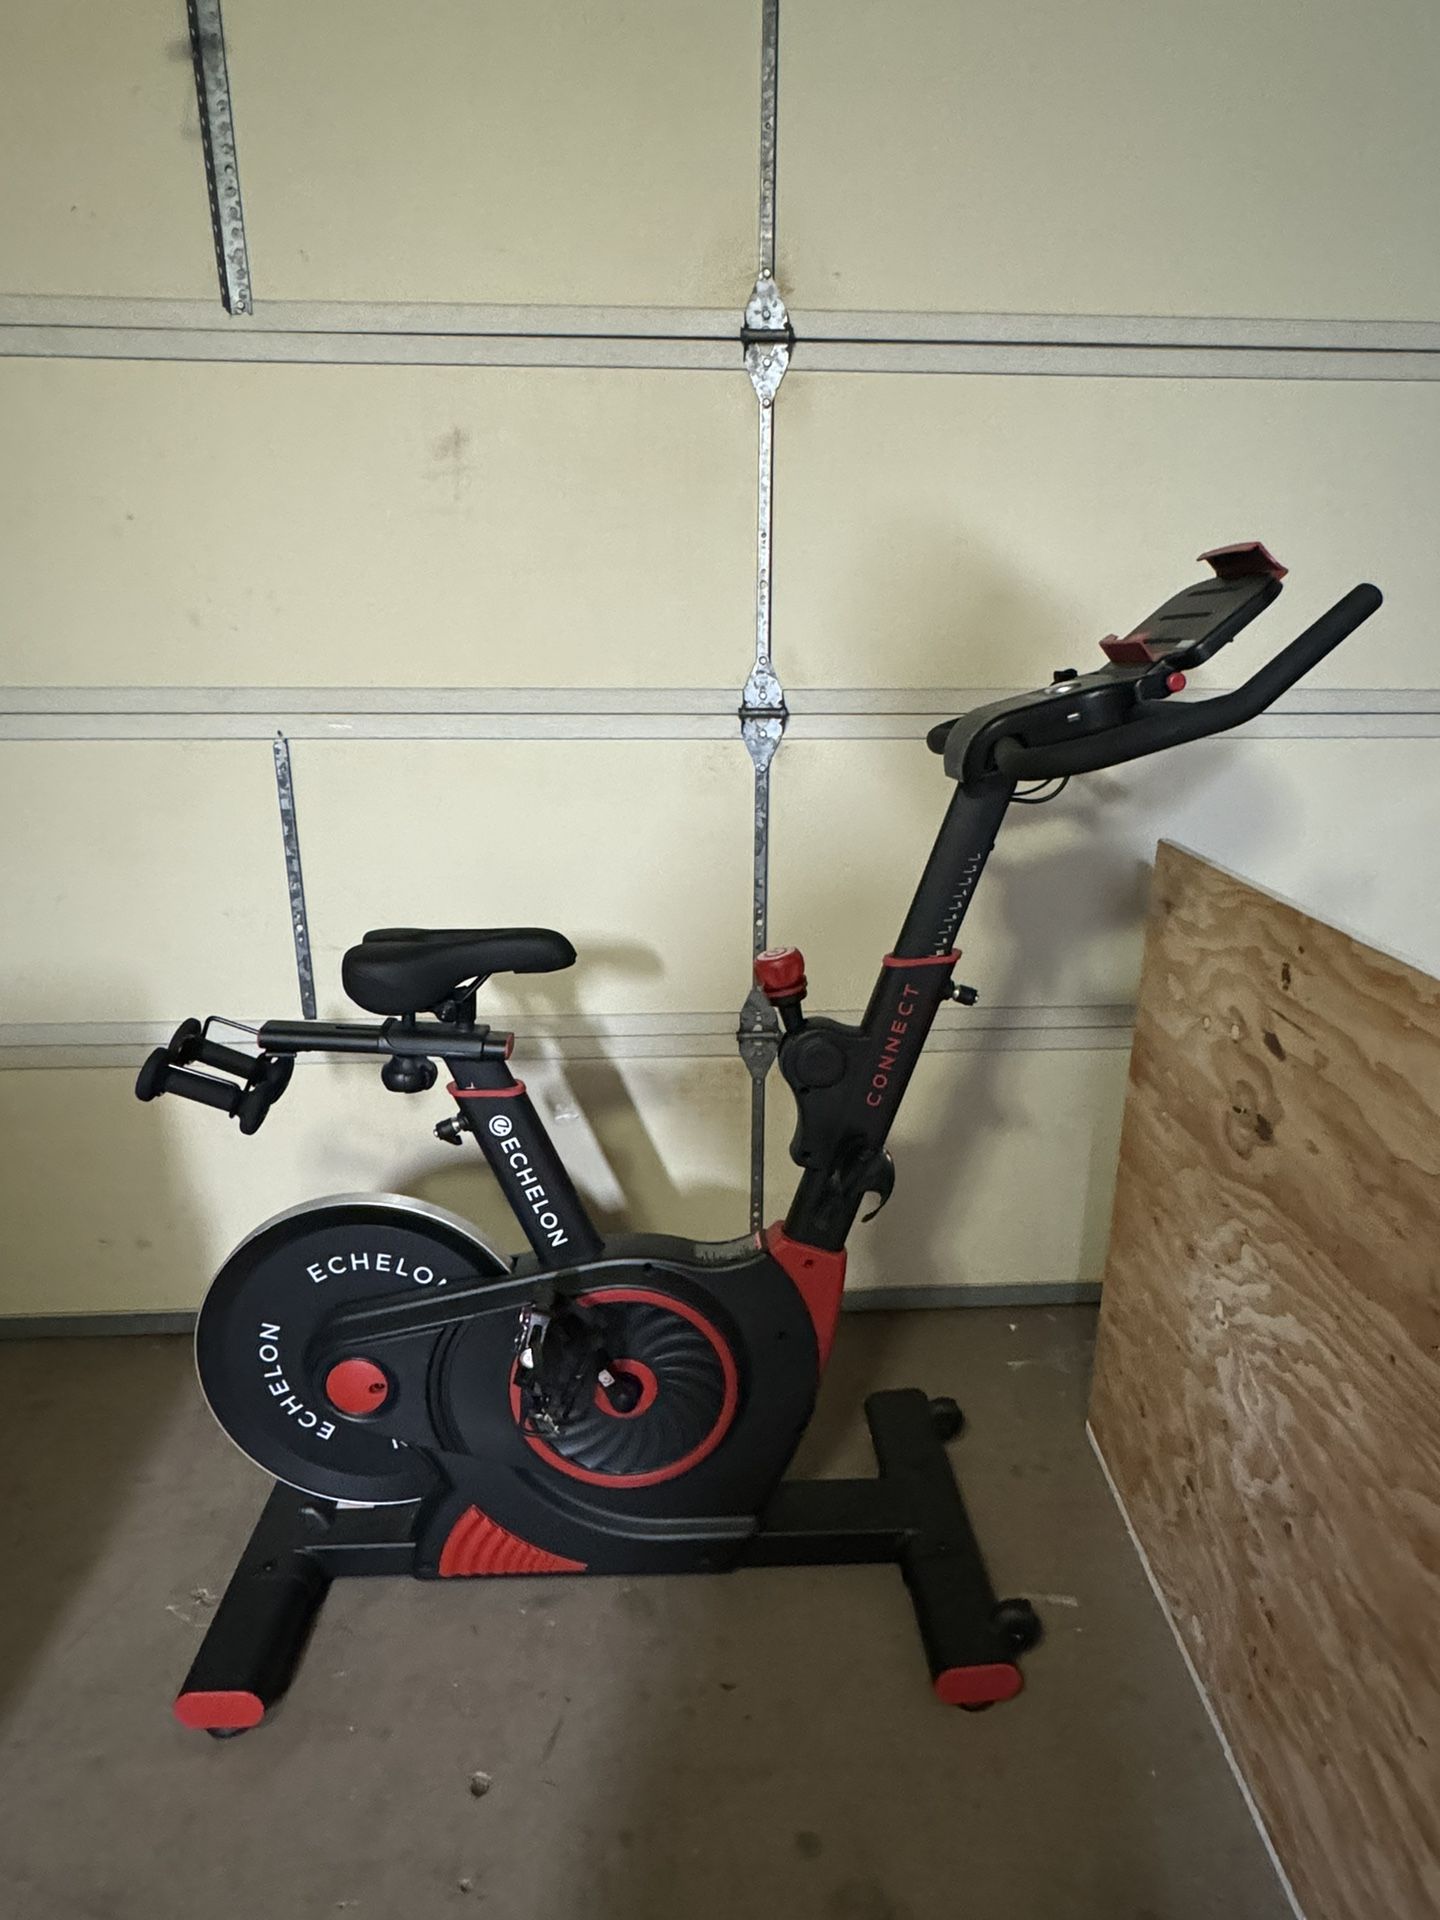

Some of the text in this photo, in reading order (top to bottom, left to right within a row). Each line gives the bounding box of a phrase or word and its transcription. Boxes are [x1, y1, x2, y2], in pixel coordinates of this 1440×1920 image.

[868, 984, 919, 1107] CONNECT
[500, 1136, 569, 1247] ECHELON
[258, 1322, 336, 1440] ECHELON
